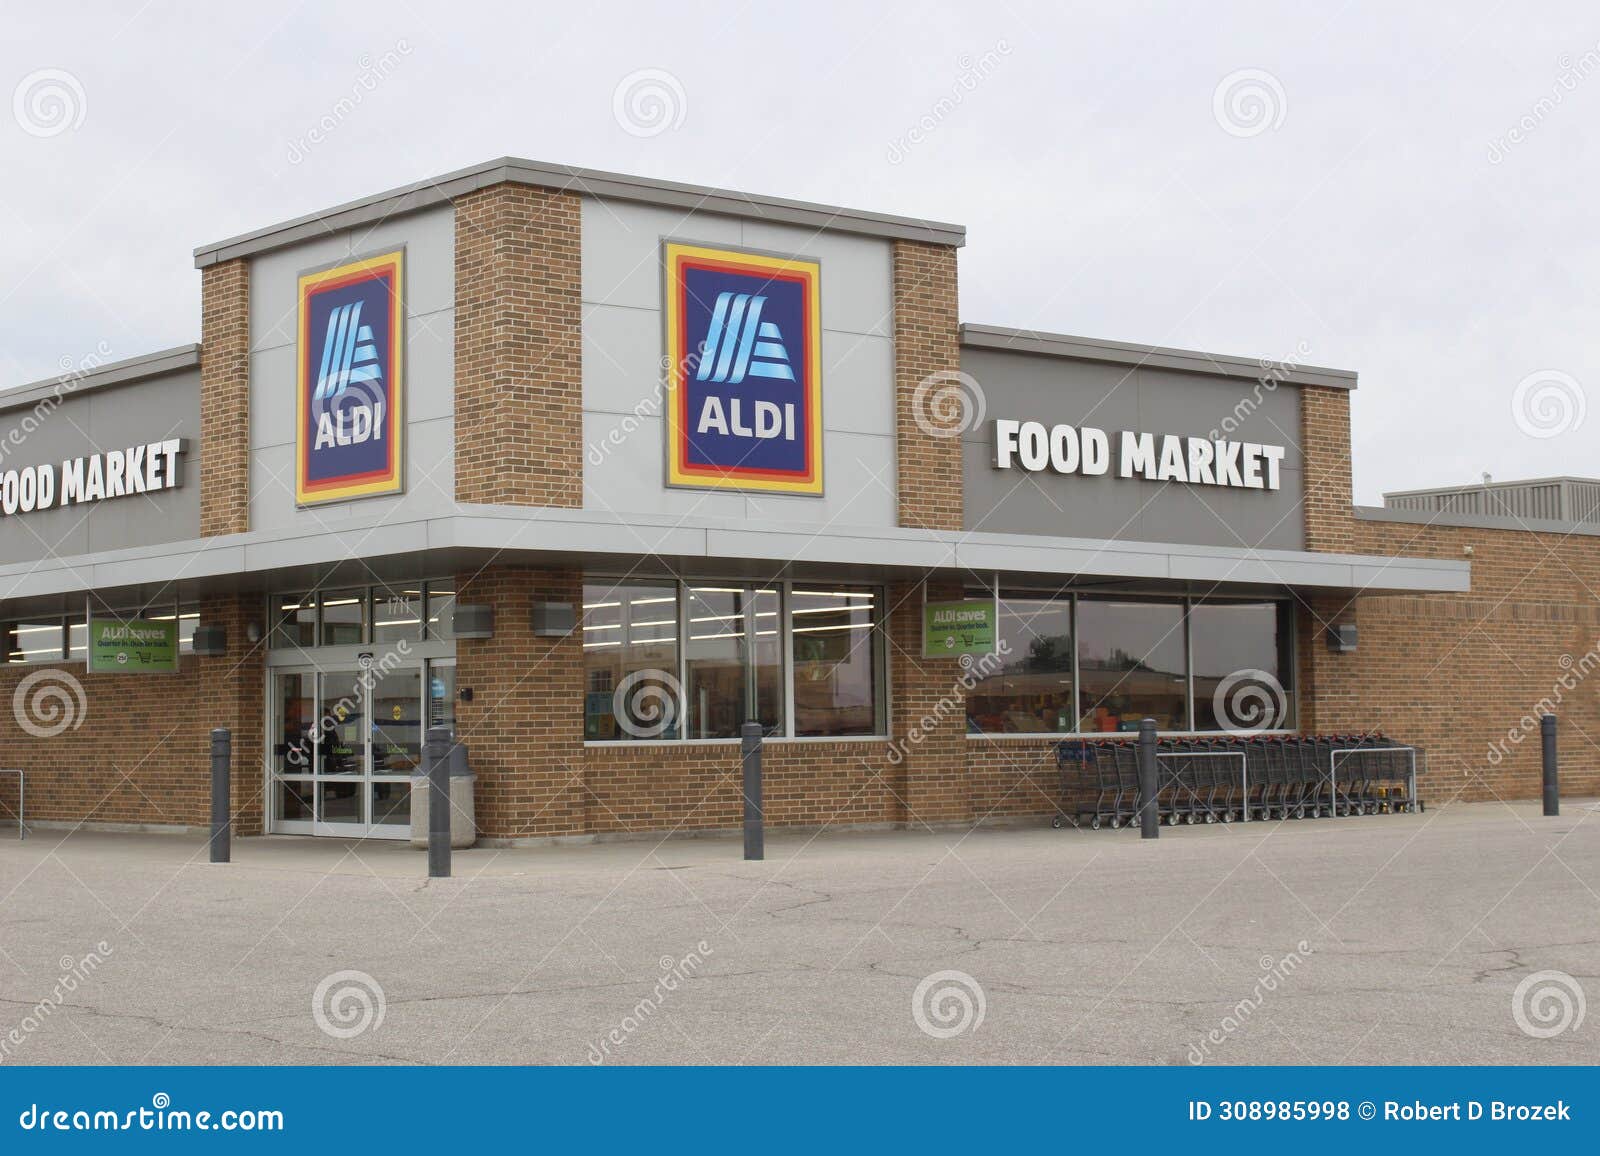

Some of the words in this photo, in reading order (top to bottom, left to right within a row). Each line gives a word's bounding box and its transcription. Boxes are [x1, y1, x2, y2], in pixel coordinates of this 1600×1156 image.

[314, 402, 381, 450] ALDI
[697, 396, 795, 441] ALDI
[0, 464, 55, 515] OOD
[60, 438, 181, 506] MARKET
[996, 419, 1110, 476] FOOD
[1120, 431, 1285, 490] MARKET
[102, 627, 129, 639] ALDI
[130, 628, 166, 639] saves
[934, 610, 956, 622] ALDI
[957, 610, 986, 621] saves
